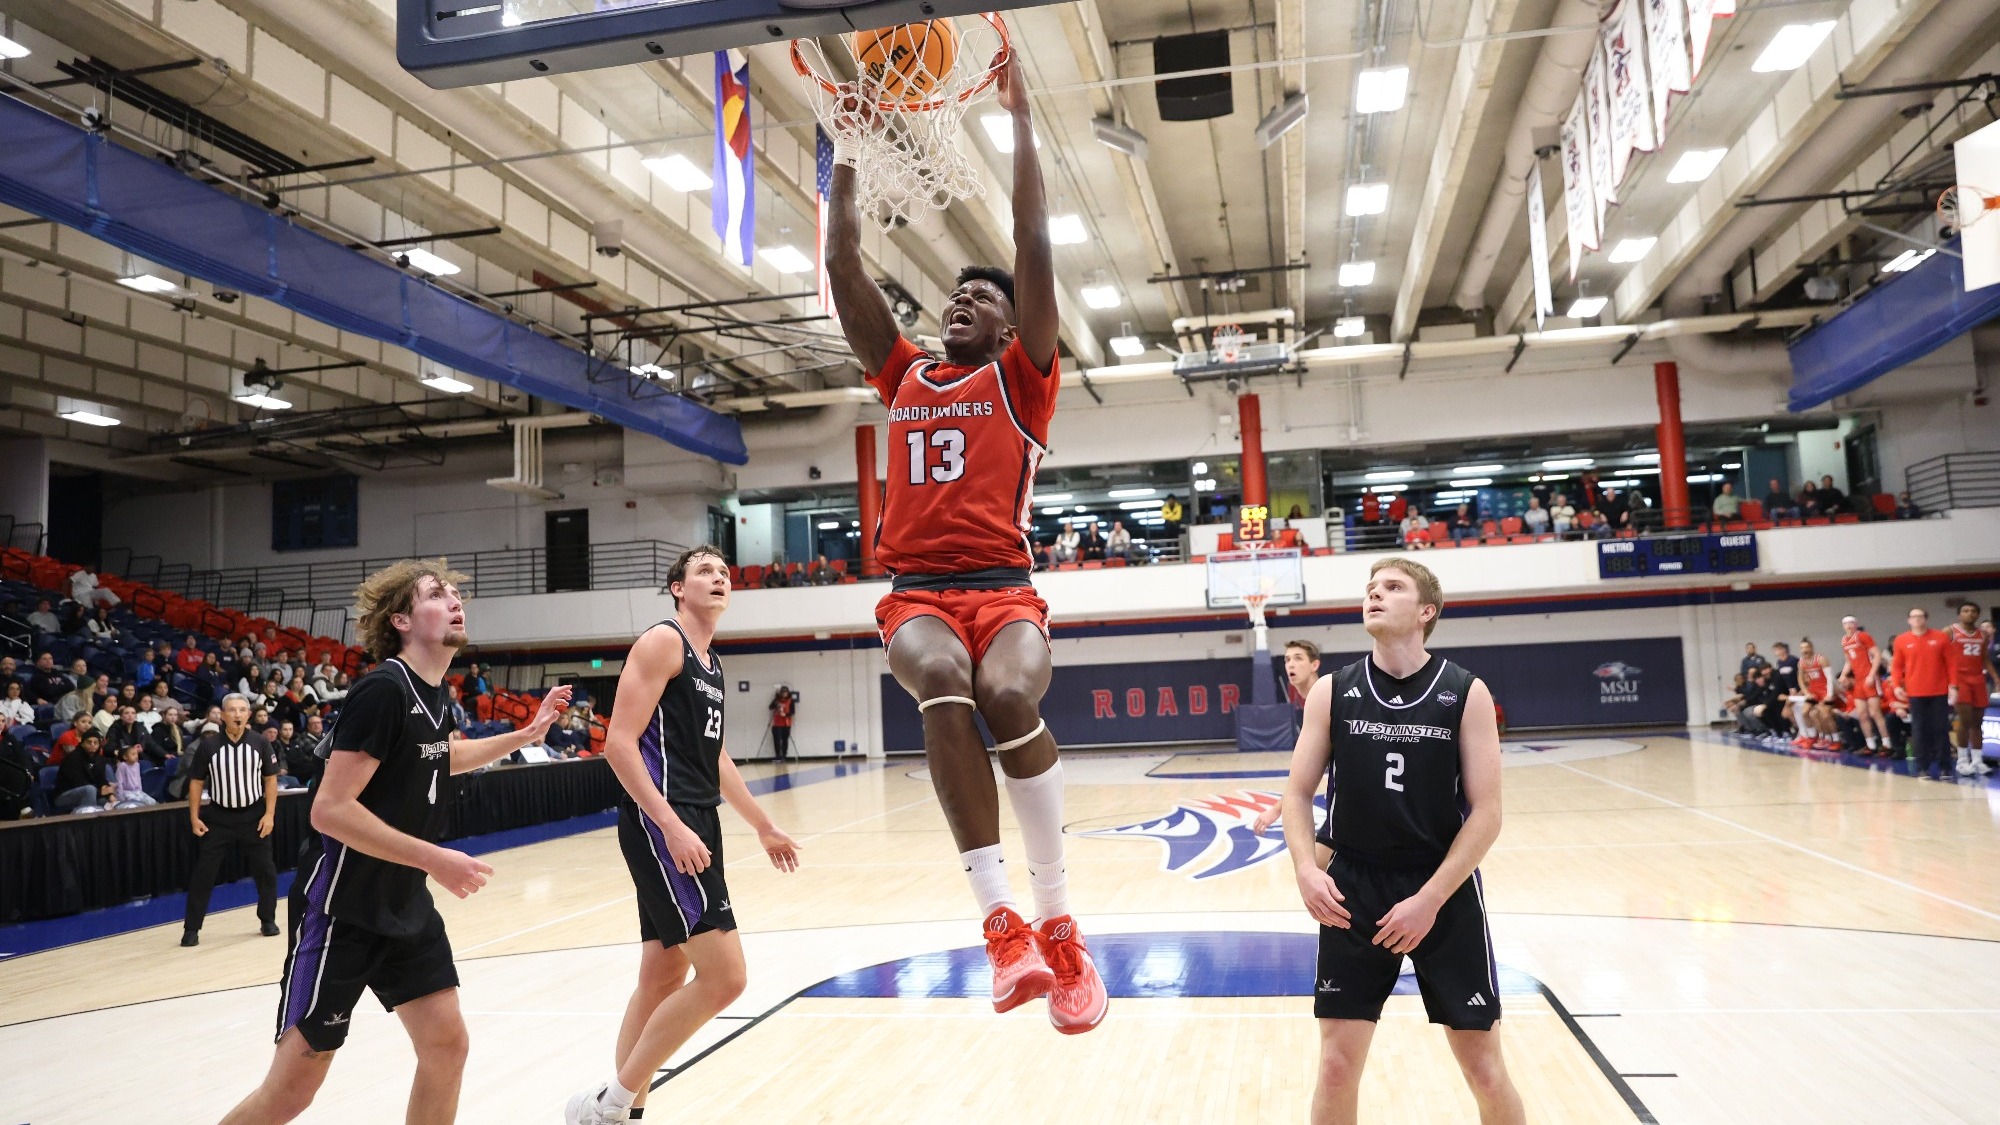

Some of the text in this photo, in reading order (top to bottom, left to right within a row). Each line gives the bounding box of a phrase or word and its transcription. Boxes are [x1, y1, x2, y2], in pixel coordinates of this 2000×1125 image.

[890, 401, 993, 423] ROADRUNNERS
[906, 427, 966, 486] 13
[1239, 519, 1264, 540] 23
[1602, 542, 1635, 554] METRO
[1719, 535, 1752, 547] GUEST
[1963, 643, 1981, 656] 22
[1600, 680, 1638, 694] MSU
[1600, 694, 1639, 704] DENVER
[704, 706, 722, 740] 23
[1385, 752, 1405, 792] 2
